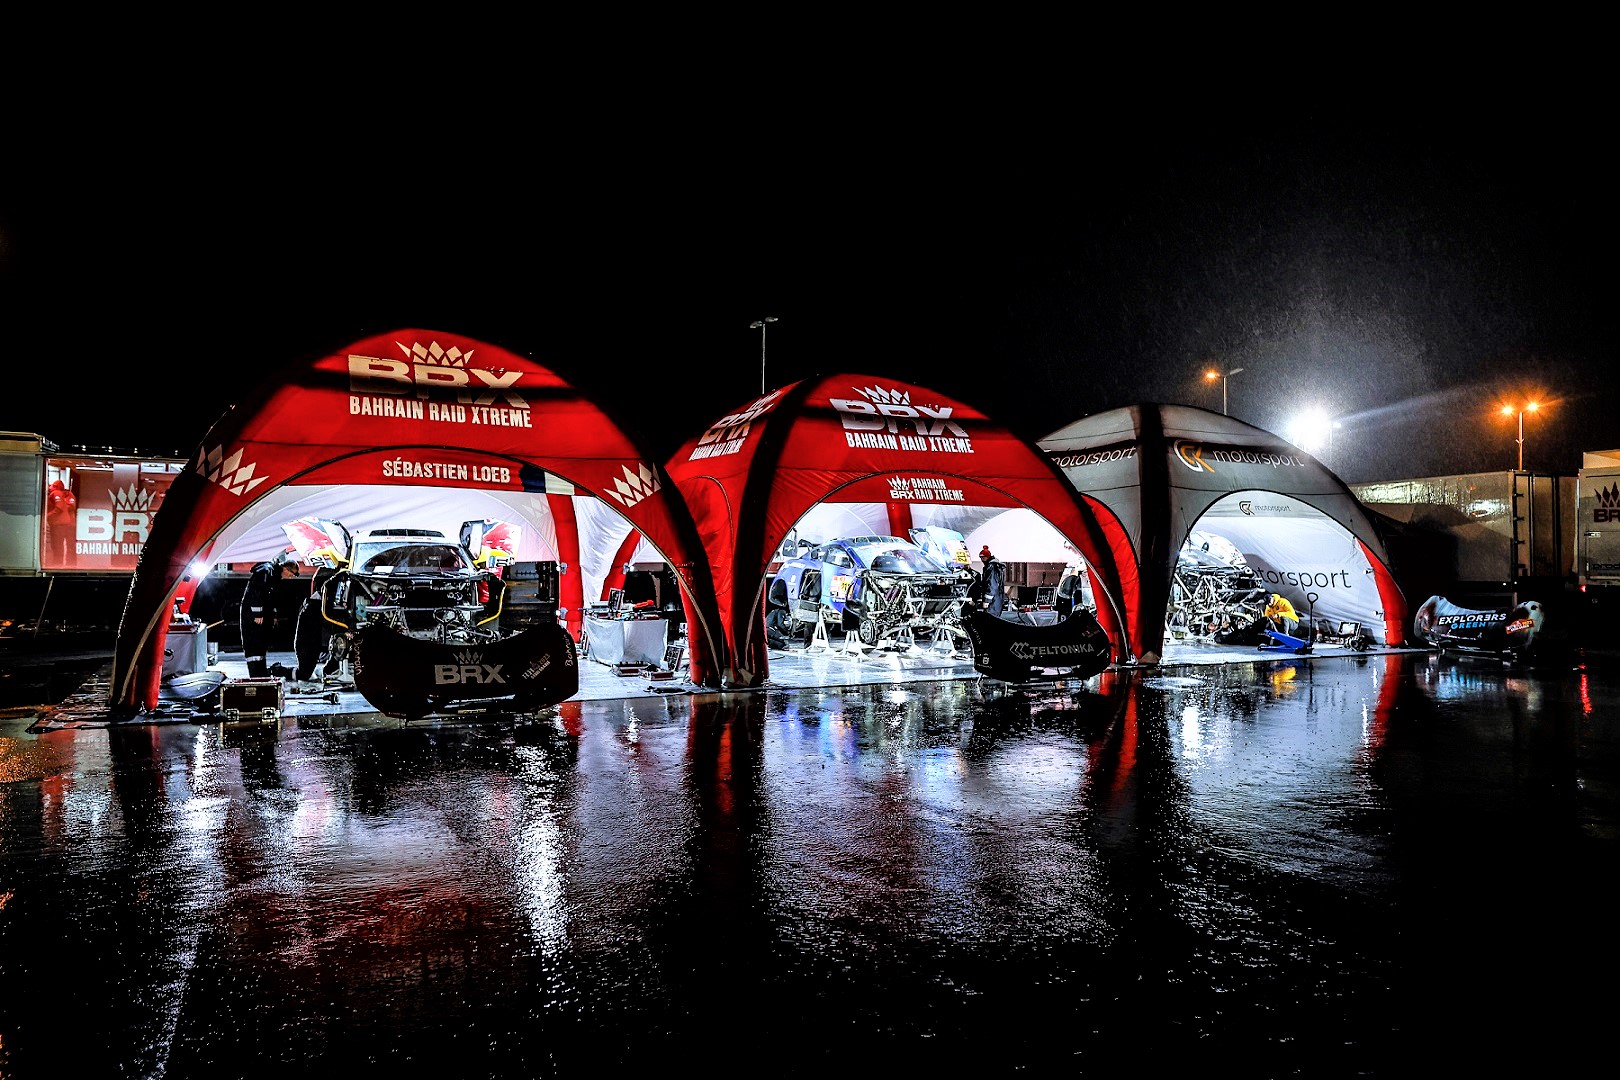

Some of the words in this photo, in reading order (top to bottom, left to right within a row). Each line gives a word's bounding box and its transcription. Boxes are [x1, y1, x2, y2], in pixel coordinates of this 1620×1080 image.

[348, 354, 531, 409] BRX
[349, 396, 424, 420] BAHRAIN
[429, 403, 466, 423] RAID
[471, 407, 533, 428] XTREME
[829, 398, 970, 437] BRX
[845, 432, 899, 450] BAHRAIN
[900, 435, 927, 451] RAID
[929, 437, 975, 454] XTREME
[1213, 448, 1305, 469] motorsport
[382, 457, 468, 481] SÉBASTIEN
[473, 466, 511, 484] LOEB
[910, 478, 947, 490] BAHRAIN
[889, 489, 915, 500] BRX
[914, 489, 934, 501] RAID
[934, 489, 966, 502] XTREME
[76, 508, 158, 542] BR
[76, 542, 119, 556] BAHRAIN
[1252, 566, 1352, 592] torsport
[1438, 613, 1507, 626] EXPLORERS
[1450, 621, 1487, 630] GREEN
[1029, 643, 1095, 656] TELTONIKA
[434, 664, 507, 685] BRX
